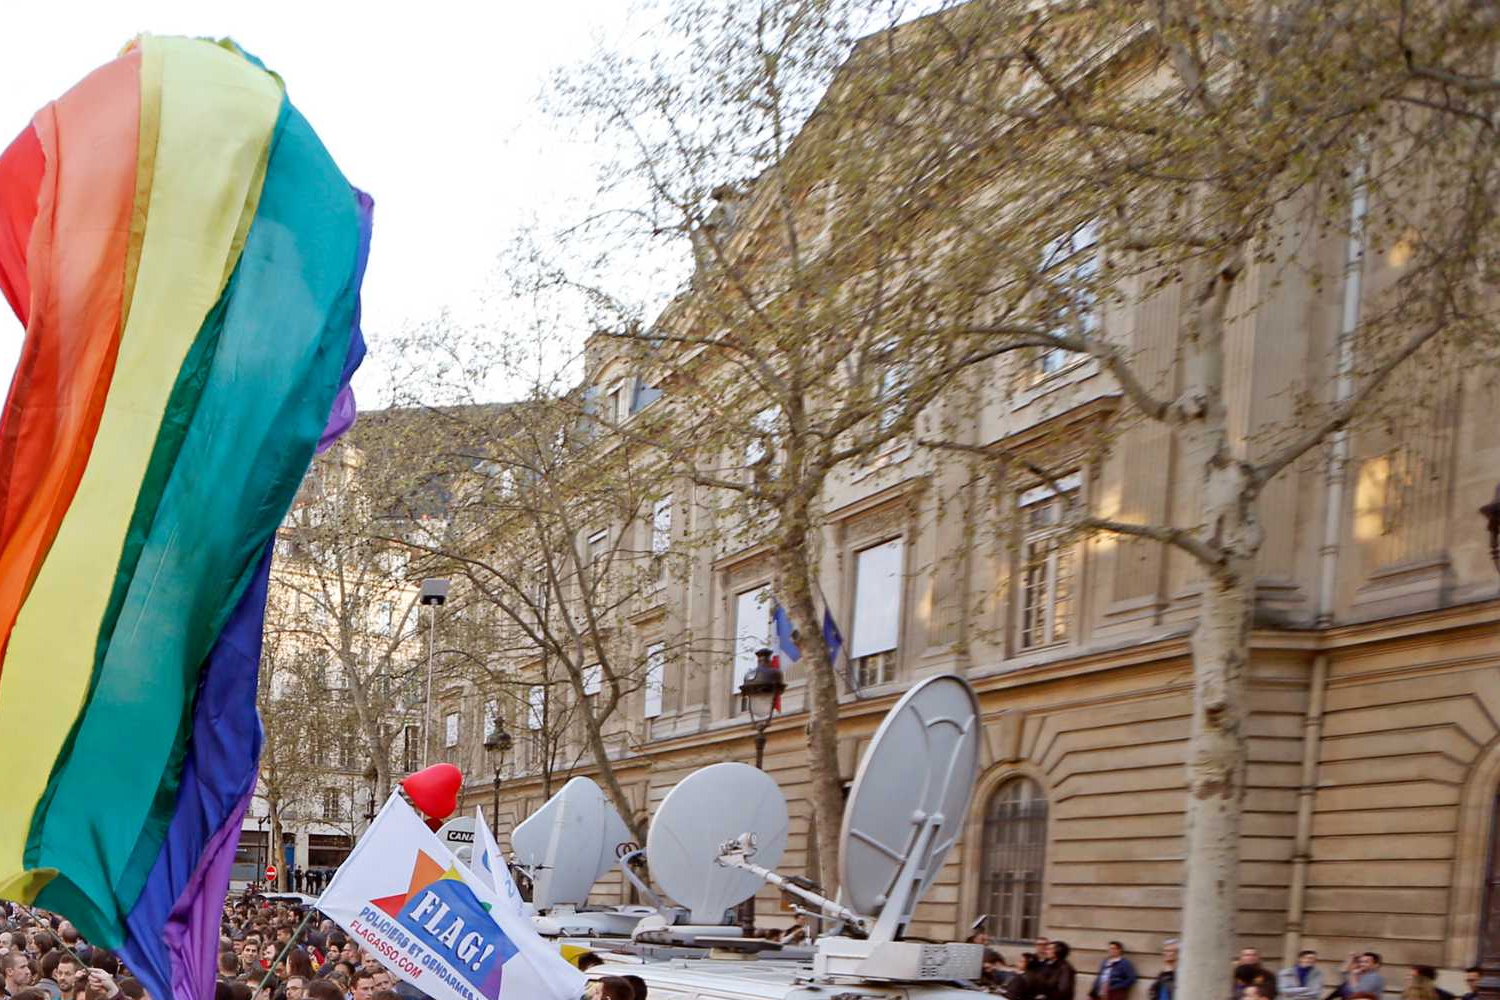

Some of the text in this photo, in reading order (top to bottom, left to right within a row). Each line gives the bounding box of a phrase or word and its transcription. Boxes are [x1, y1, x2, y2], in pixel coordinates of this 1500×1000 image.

[349, 920, 423, 979] FLAGASSO.COM
[360, 907, 410, 949] POLICIERS
[408, 940, 424, 958] ET
[408, 890, 494, 972] FLAG!
